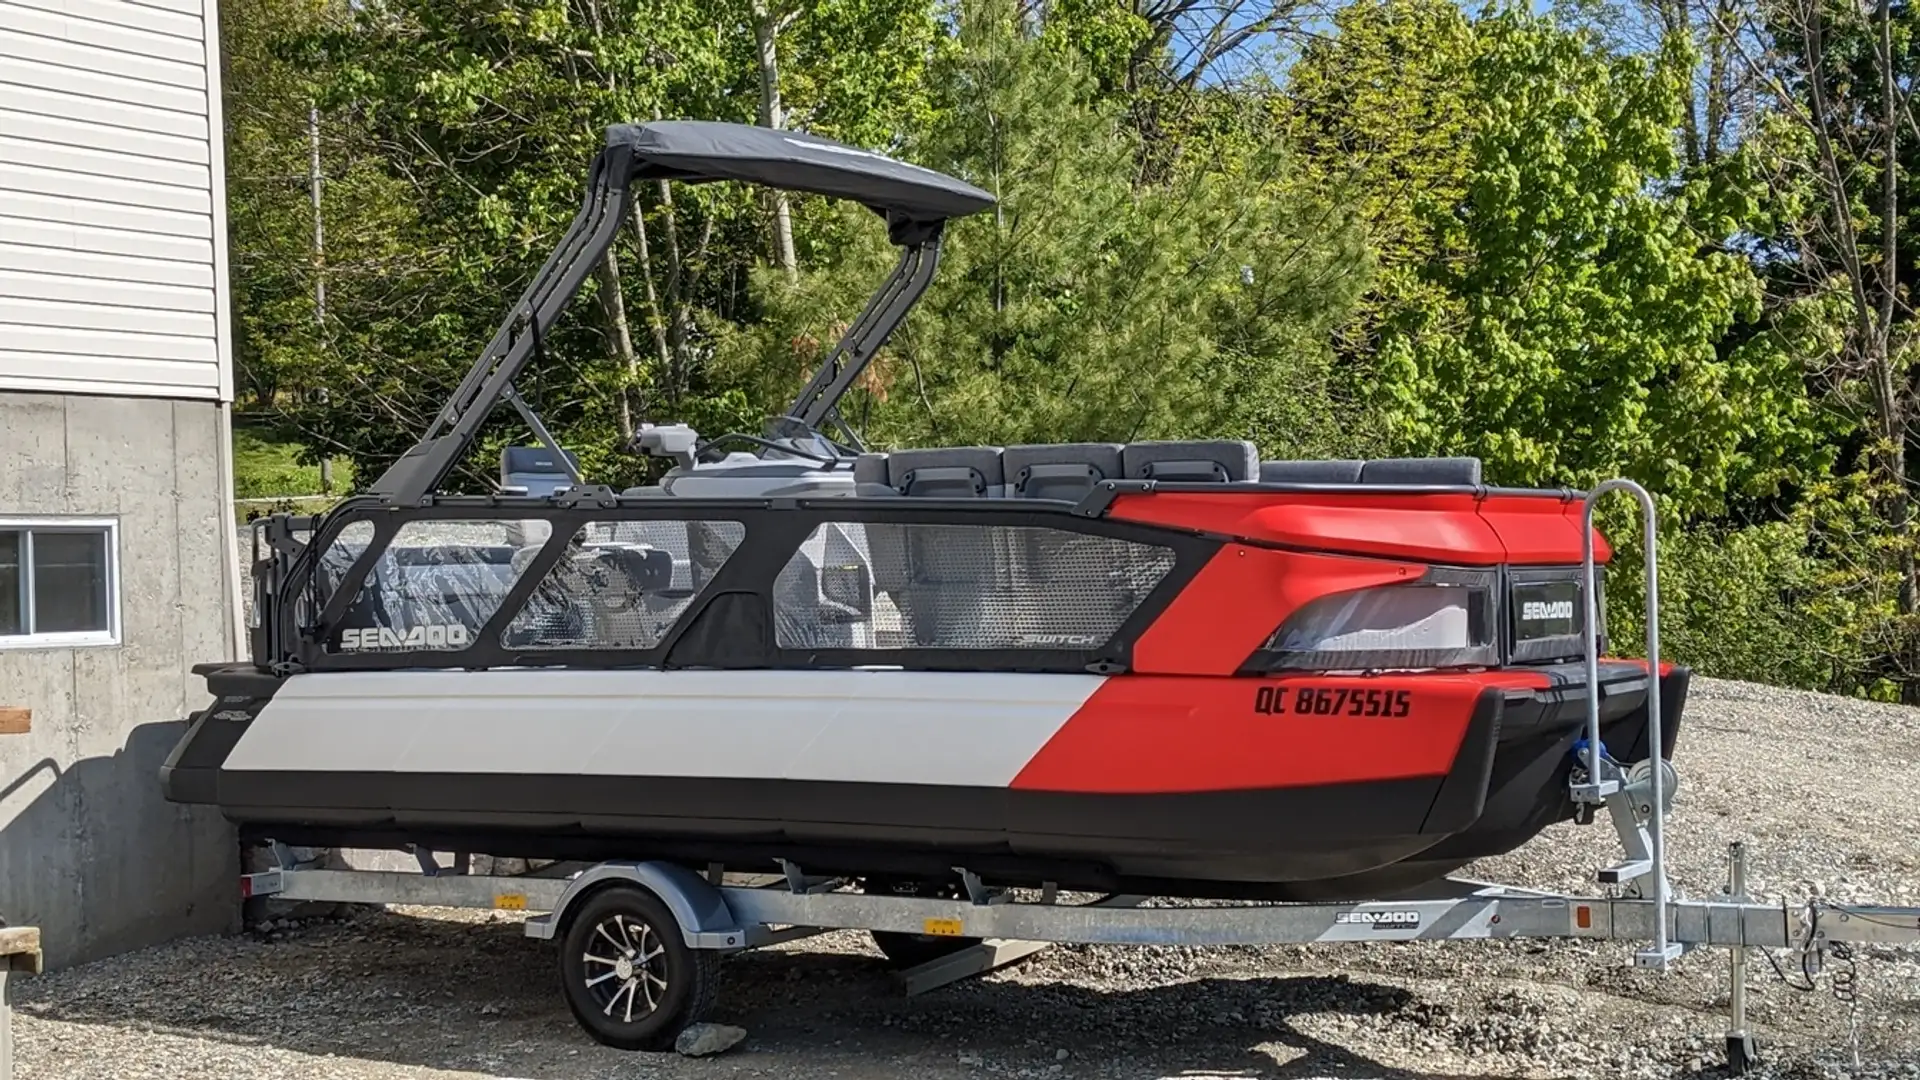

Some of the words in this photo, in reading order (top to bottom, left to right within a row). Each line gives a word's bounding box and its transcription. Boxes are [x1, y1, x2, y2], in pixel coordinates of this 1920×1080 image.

[1022, 635, 1095, 645] SWITCH
[1255, 687, 1289, 715] QC
[1295, 688, 1411, 717] 8675515
